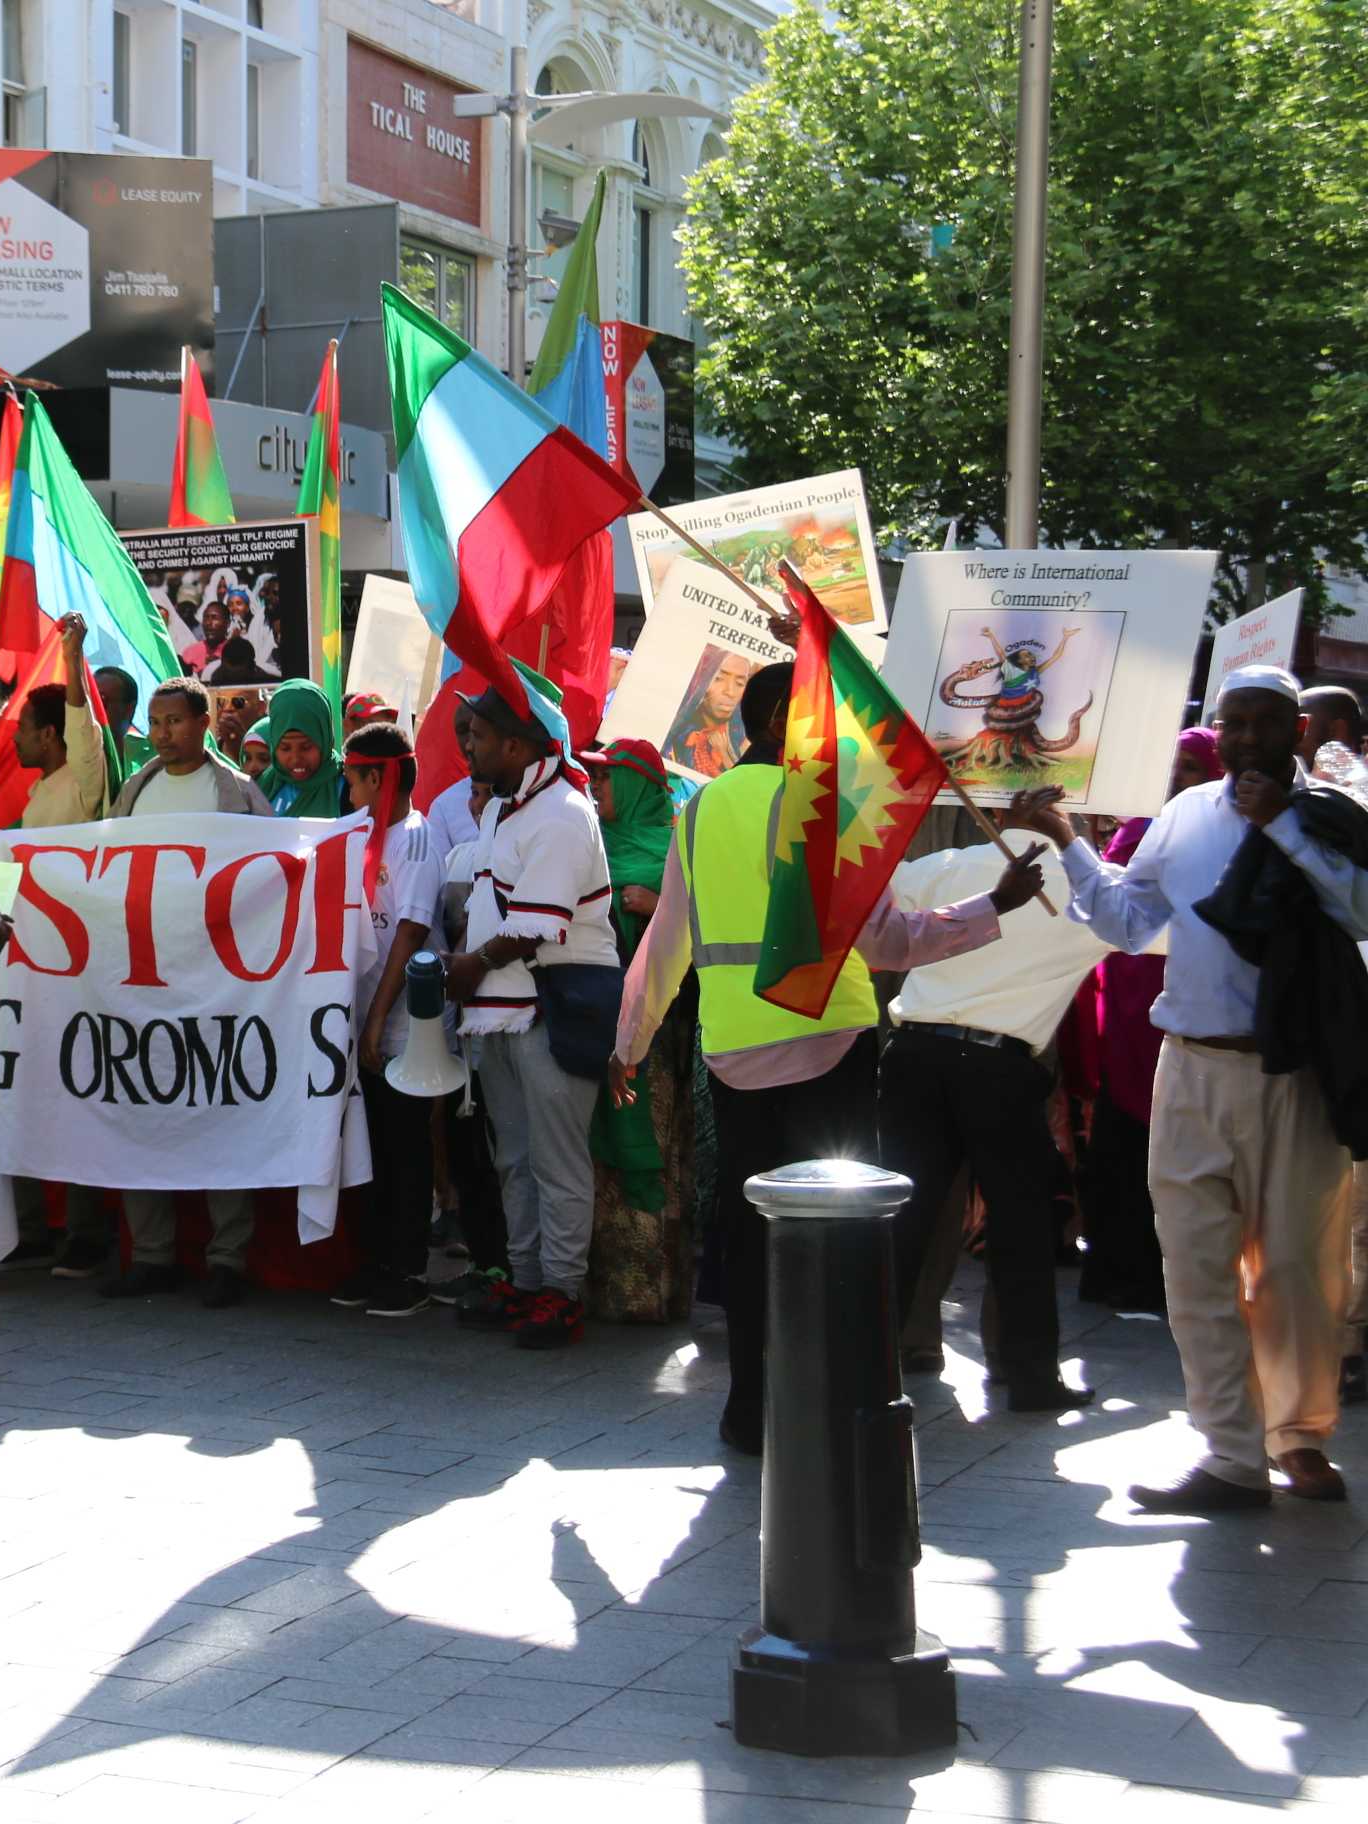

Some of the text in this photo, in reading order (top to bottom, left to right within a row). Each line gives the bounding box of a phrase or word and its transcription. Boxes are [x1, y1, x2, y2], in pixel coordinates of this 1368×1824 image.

[401, 81, 427, 114] THE
[369, 100, 471, 165] TICAL HOUSE
[120, 187, 203, 204] LEASE EQUITY
[30, 268, 84, 281] LOCATION
[26, 280, 65, 293] TERMS
[104, 283, 131, 296] 0411
[602, 325, 619, 377] NOW
[605, 394, 617, 467] LEAS
[635, 487, 862, 542] Stop illing Ogadenian People.
[147, 547, 190, 559] SECURITY
[190, 544, 230, 556] COUNCIL
[230, 542, 249, 553] FOR
[250, 539, 296, 551] GENOCIDE
[161, 537, 186, 549] MUST
[186, 535, 221, 548] REPORT
[223, 533, 241, 544] THE
[242, 531, 265, 542] TPLF
[265, 528, 299, 541] REGIME
[136, 551, 275, 570] AND CRIMES AGAINST HUMANITY
[963, 562, 1130, 581] Where is International
[682, 583, 739, 617] UNITED
[989, 589, 1092, 611] Community?
[708, 619, 781, 660] TERFERE
[1004, 638, 1047, 653] Ogaden
[59, 1010, 278, 1108] OROMO
